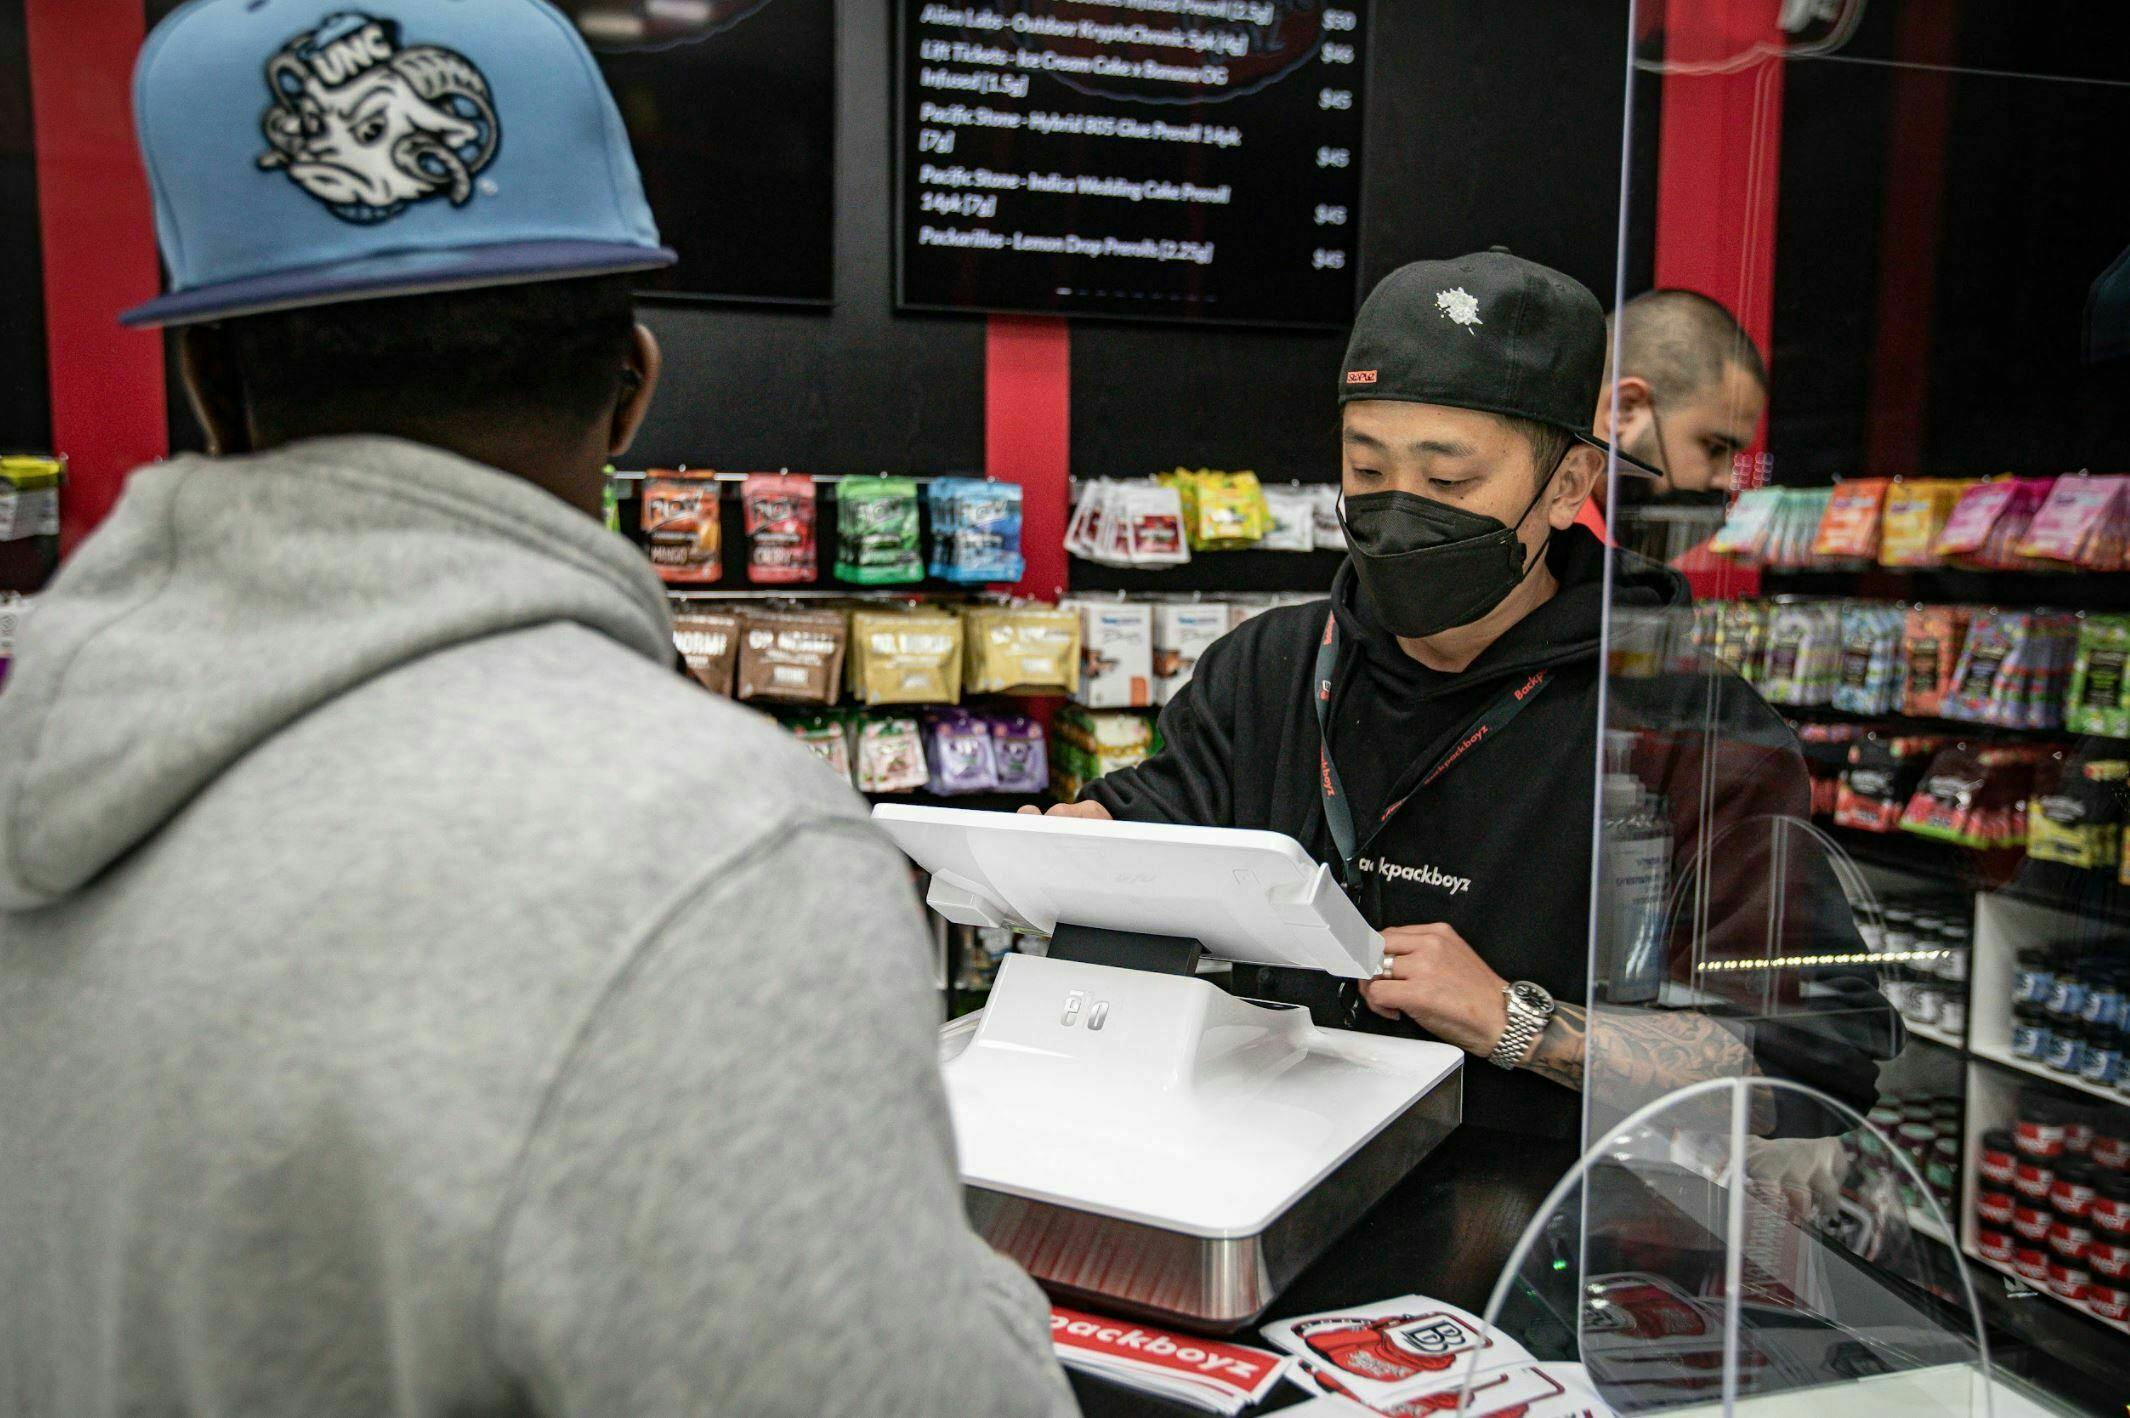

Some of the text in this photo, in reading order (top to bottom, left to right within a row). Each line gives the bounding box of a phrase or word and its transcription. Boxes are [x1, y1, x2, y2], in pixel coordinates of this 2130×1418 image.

[921, 5, 964, 26] Alien
[313, 23, 391, 85] UNC
[952, 42, 1008, 65] Tickets
[921, 103, 974, 126] Pacific
[974, 107, 1021, 128] Stone
[1028, 112, 1083, 134] Hybrid
[1316, 146, 1350, 168] $45
[920, 165, 973, 187] Pacific
[973, 169, 1020, 189] Stone
[1027, 173, 1077, 193] Indica
[1077, 177, 1143, 201] Wedding
[1314, 203, 1347, 225] $45
[1012, 233, 1065, 252] Lemon
[1312, 247, 1345, 270] $45
[651, 545, 688, 564] MANGO
